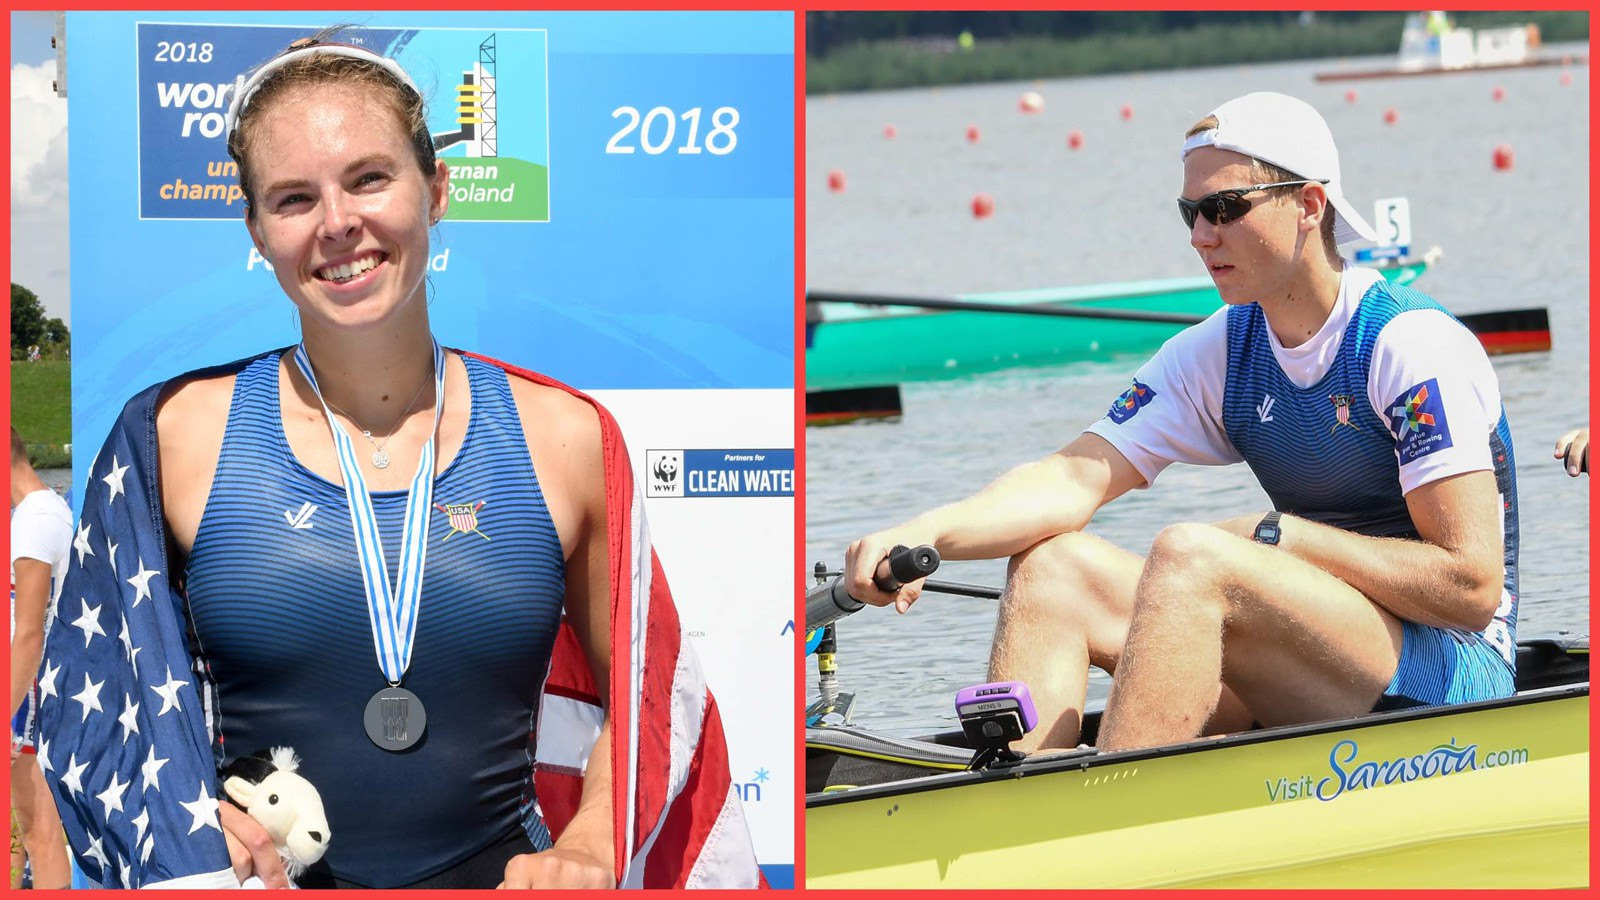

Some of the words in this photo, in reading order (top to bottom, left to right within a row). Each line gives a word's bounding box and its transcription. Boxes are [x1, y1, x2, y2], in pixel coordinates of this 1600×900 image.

[154, 41, 214, 63] 2018
[605, 106, 740, 155] 2018
[159, 178, 247, 206] champ
[1388, 204, 1400, 242] 5
[1418, 433, 1443, 445] Rowing
[724, 454, 754, 462] Partners
[755, 454, 766, 462] for
[653, 485, 677, 493] WWF
[688, 470, 739, 493] CLEAN
[450, 506, 471, 515] USA
